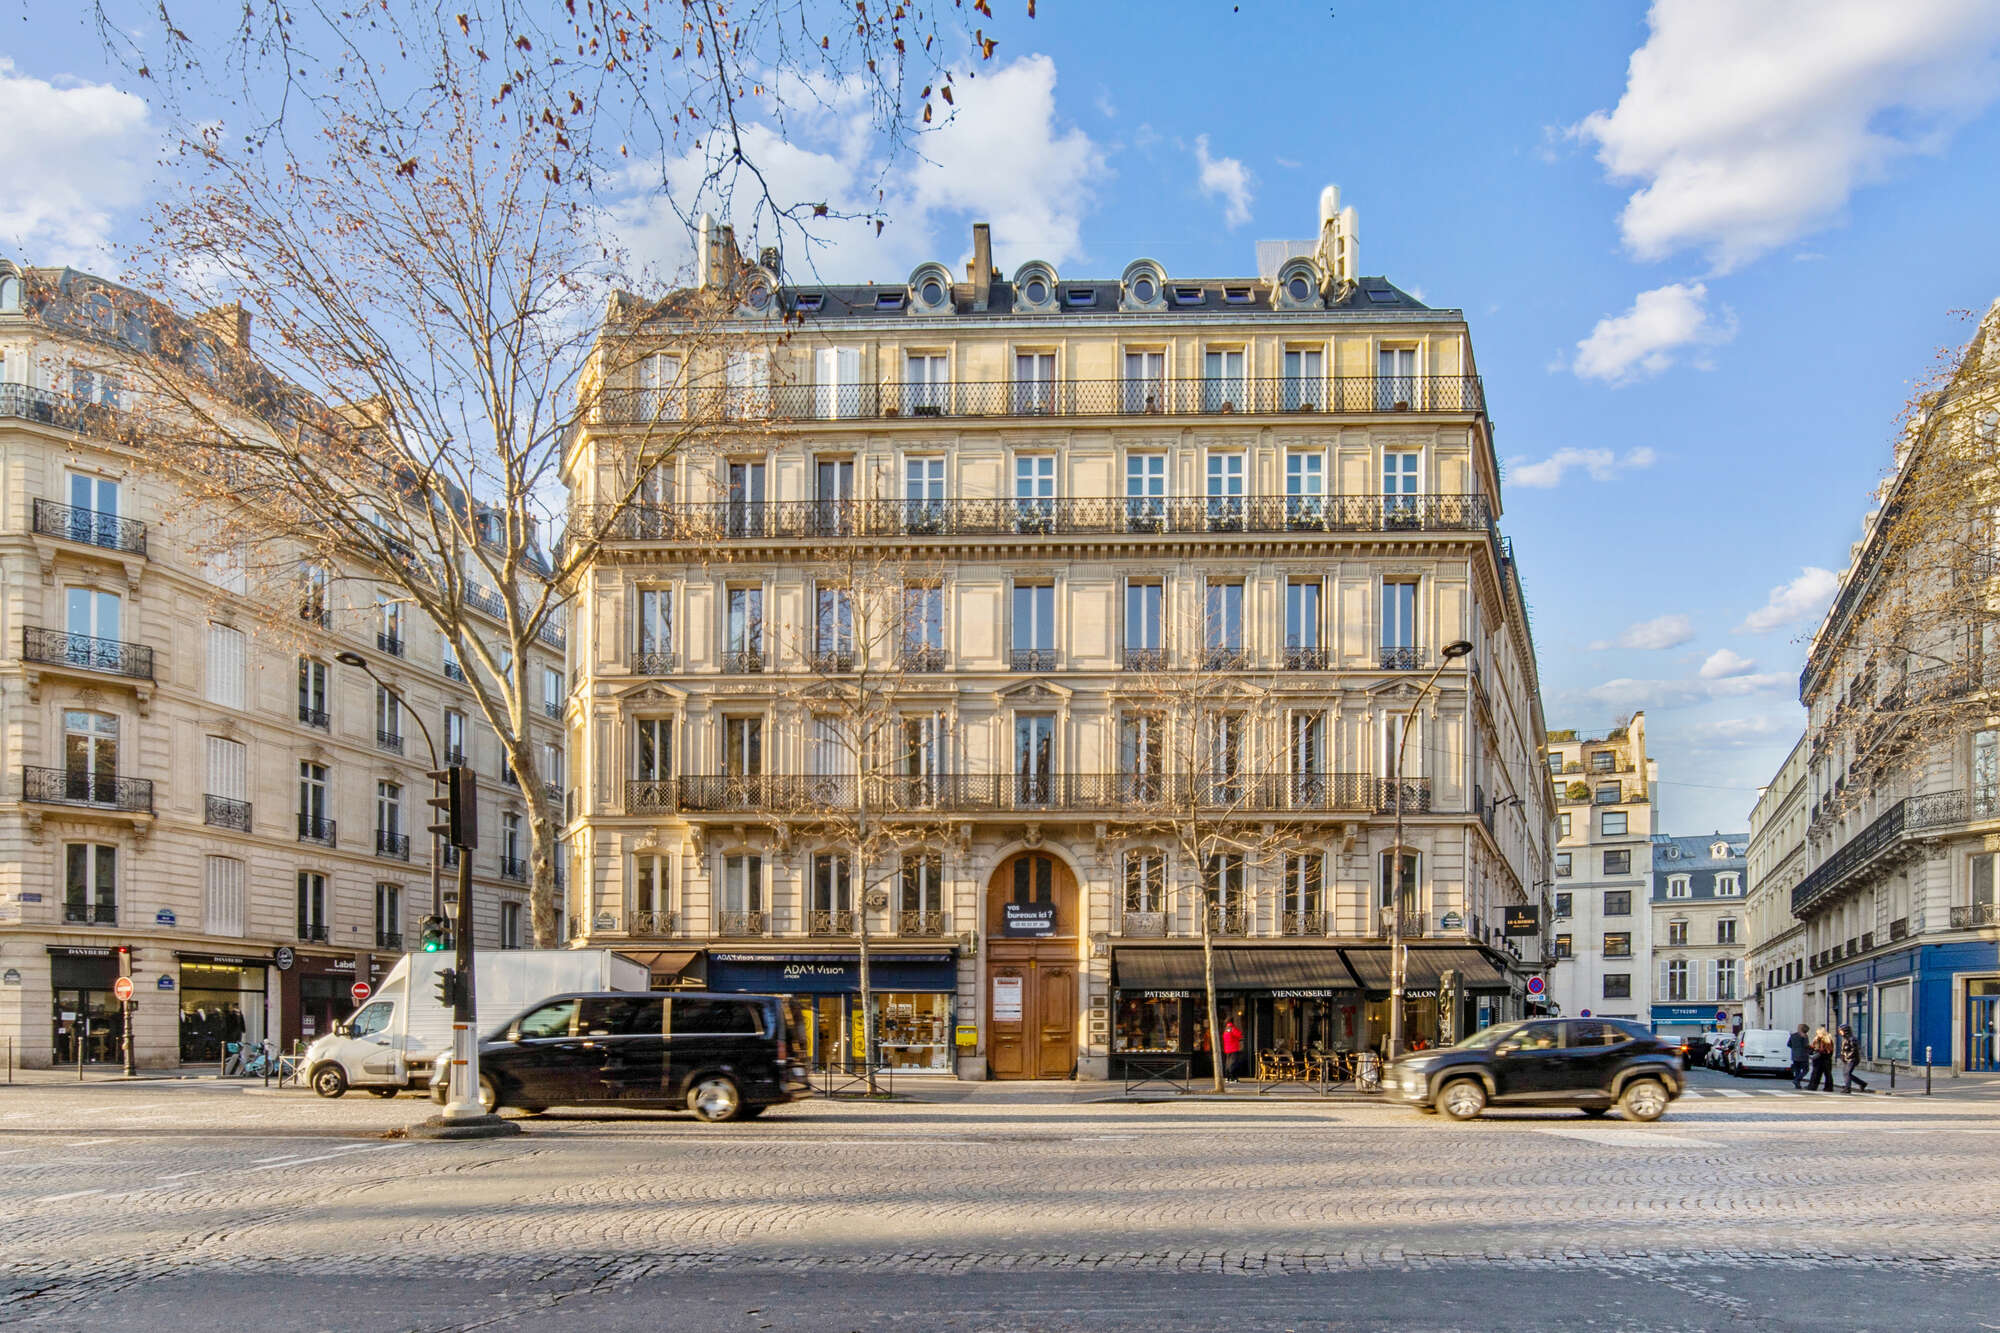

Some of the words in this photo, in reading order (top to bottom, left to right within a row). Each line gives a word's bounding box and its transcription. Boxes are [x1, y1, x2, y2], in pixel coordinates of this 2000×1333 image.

[1007, 911, 1037, 919] bureaux
[783, 965, 815, 974] ADAM
[817, 965, 844, 975] Vision
[1144, 990, 1190, 998] PATISSERIE
[1271, 990, 1333, 998] VIENNOISERIE
[1407, 990, 1436, 998] SALON
